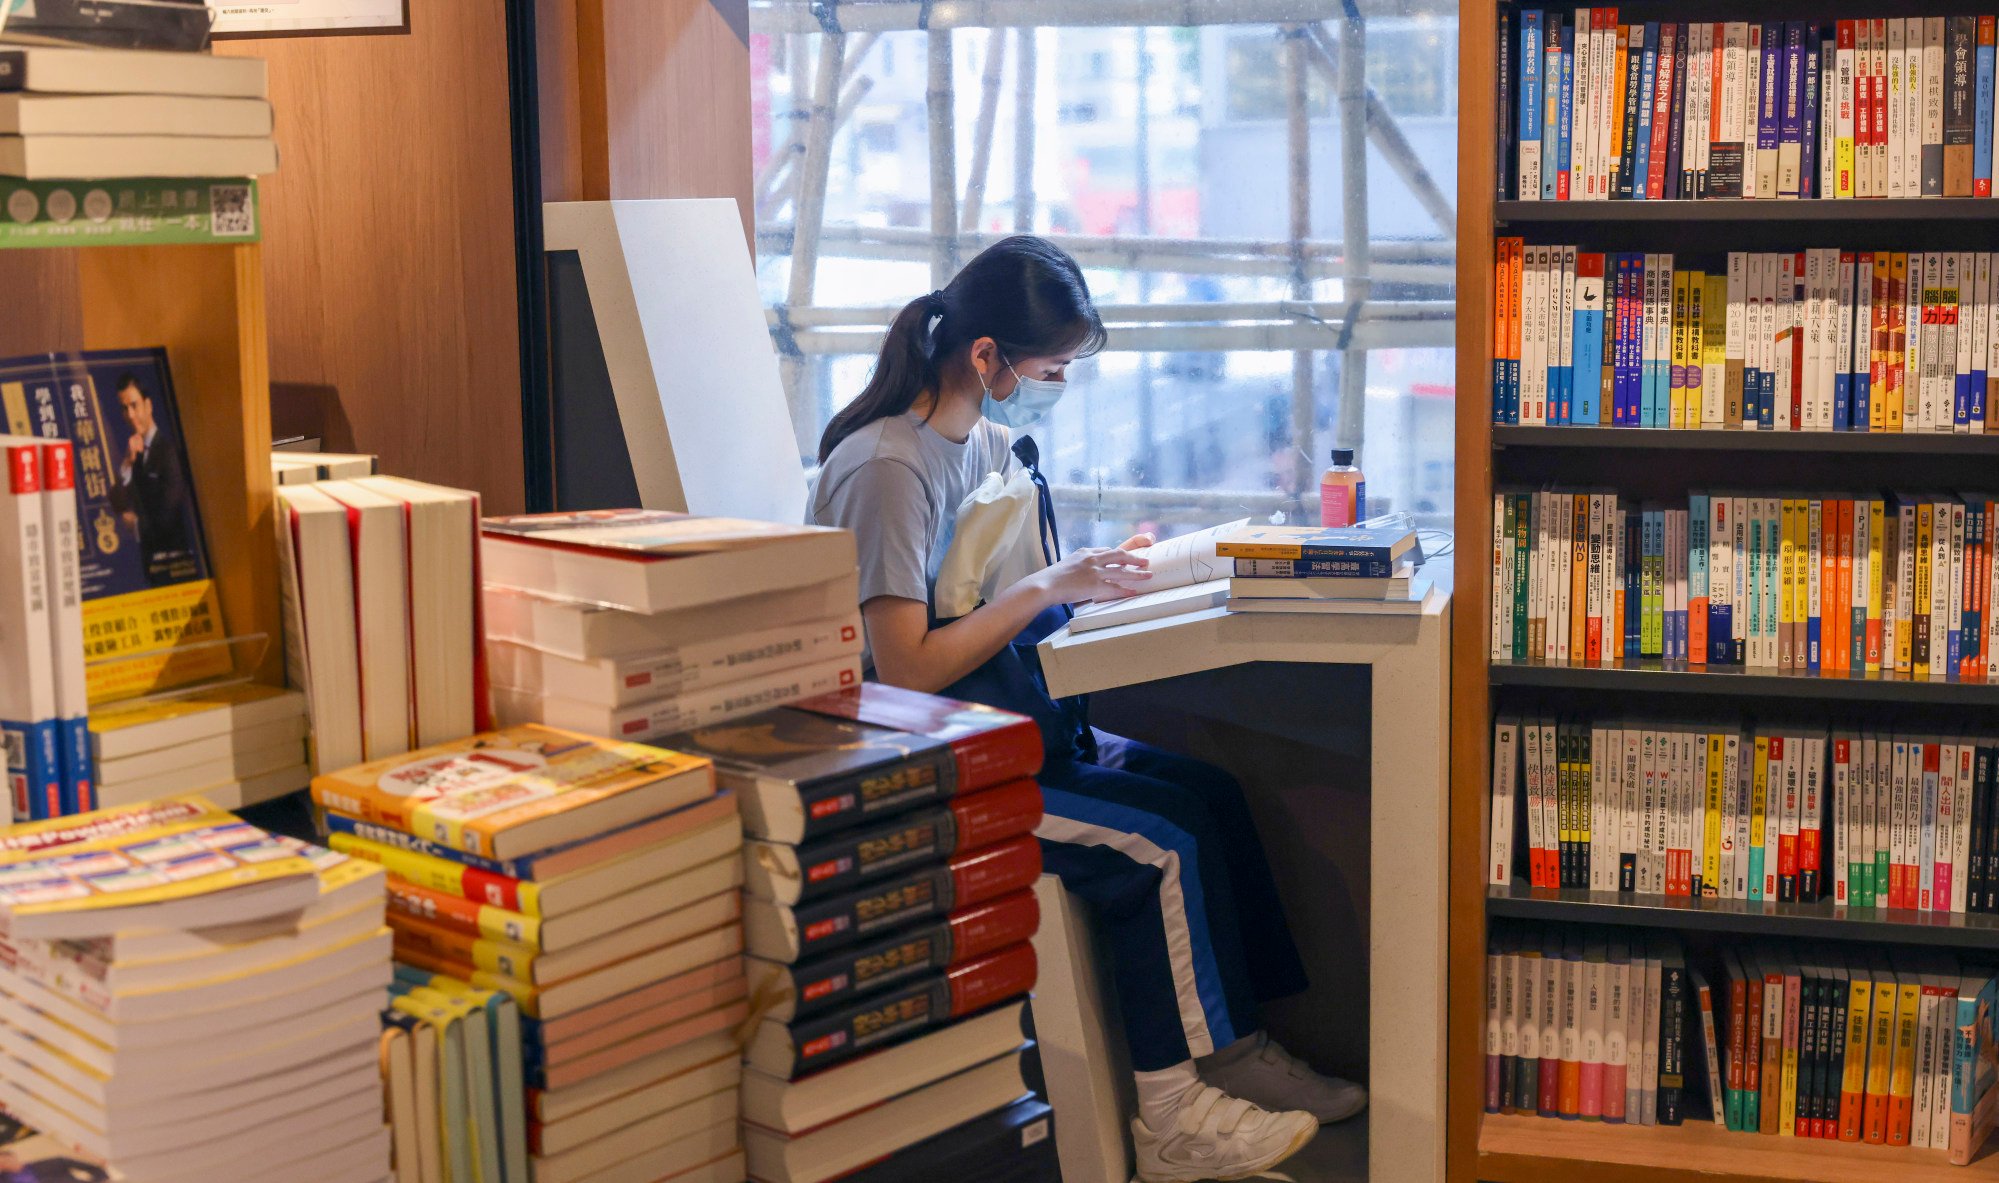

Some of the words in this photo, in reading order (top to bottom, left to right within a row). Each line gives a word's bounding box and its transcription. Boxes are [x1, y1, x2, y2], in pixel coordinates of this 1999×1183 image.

[1657, 36, 1673, 113] 管理者解答之書
[1725, 37, 1737, 83] 模範領導
[1953, 33, 1968, 87] 學會領導
[1645, 270, 1656, 325] 商業用語事典
[1660, 270, 1671, 325] 商業用語事典
[70, 384, 108, 498] 我在華爾街
[1590, 533, 1601, 574] 變動思維
[1937, 537, 1947, 568] 從A到A+
[1527, 764, 1540, 809] 快速致勝
[1543, 764, 1557, 809] 快速致勝
